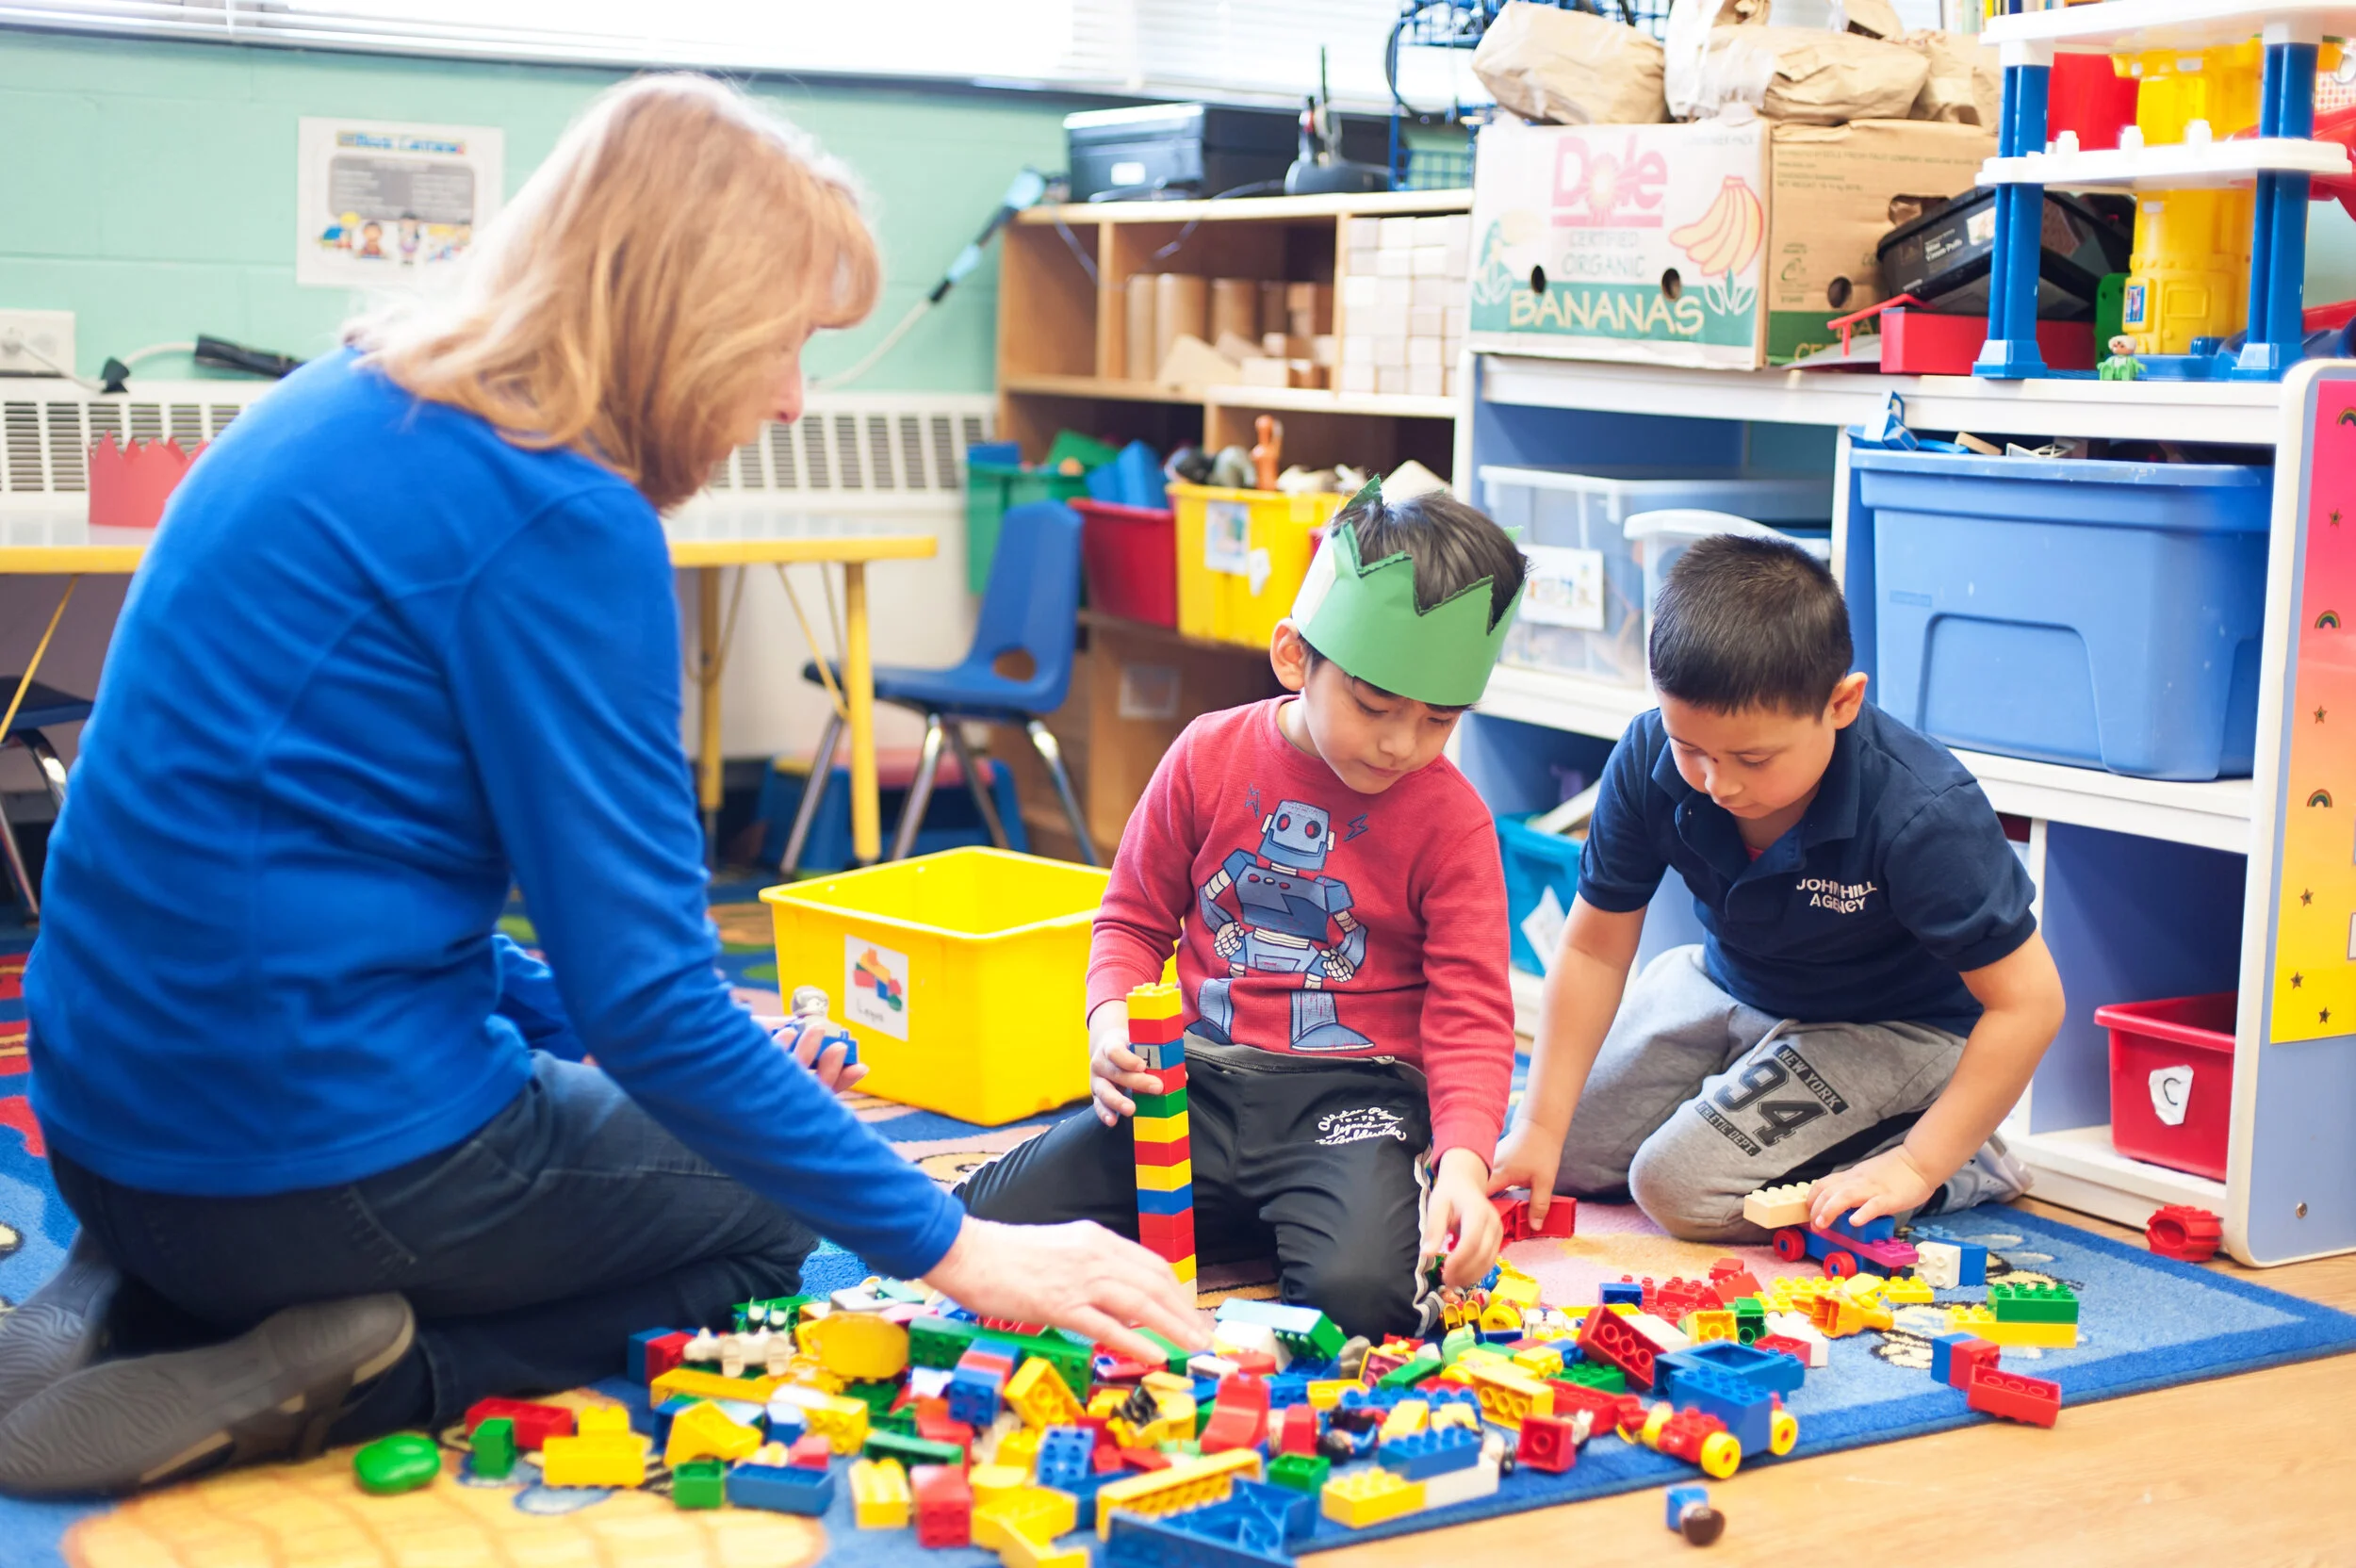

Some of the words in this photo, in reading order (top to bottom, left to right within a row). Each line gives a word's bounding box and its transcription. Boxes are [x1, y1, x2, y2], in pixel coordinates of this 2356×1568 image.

[1551, 134, 1668, 211] Dole
[1568, 230, 1640, 248] CERTIFIED
[1562, 252, 1645, 278] ORGANIC
[1509, 288, 1705, 335] BANANAS
[1796, 878, 1840, 896] JOHN
[1840, 880, 1878, 900] HILL
[1808, 892, 1866, 914] AGENCY
[1777, 1048, 1808, 1074] NEW
[1803, 1070, 1842, 1112] YORK
[2163, 1077, 2182, 1106] C
[1713, 1058, 1828, 1148] 94
[1729, 1127, 1757, 1156] DEPT.
